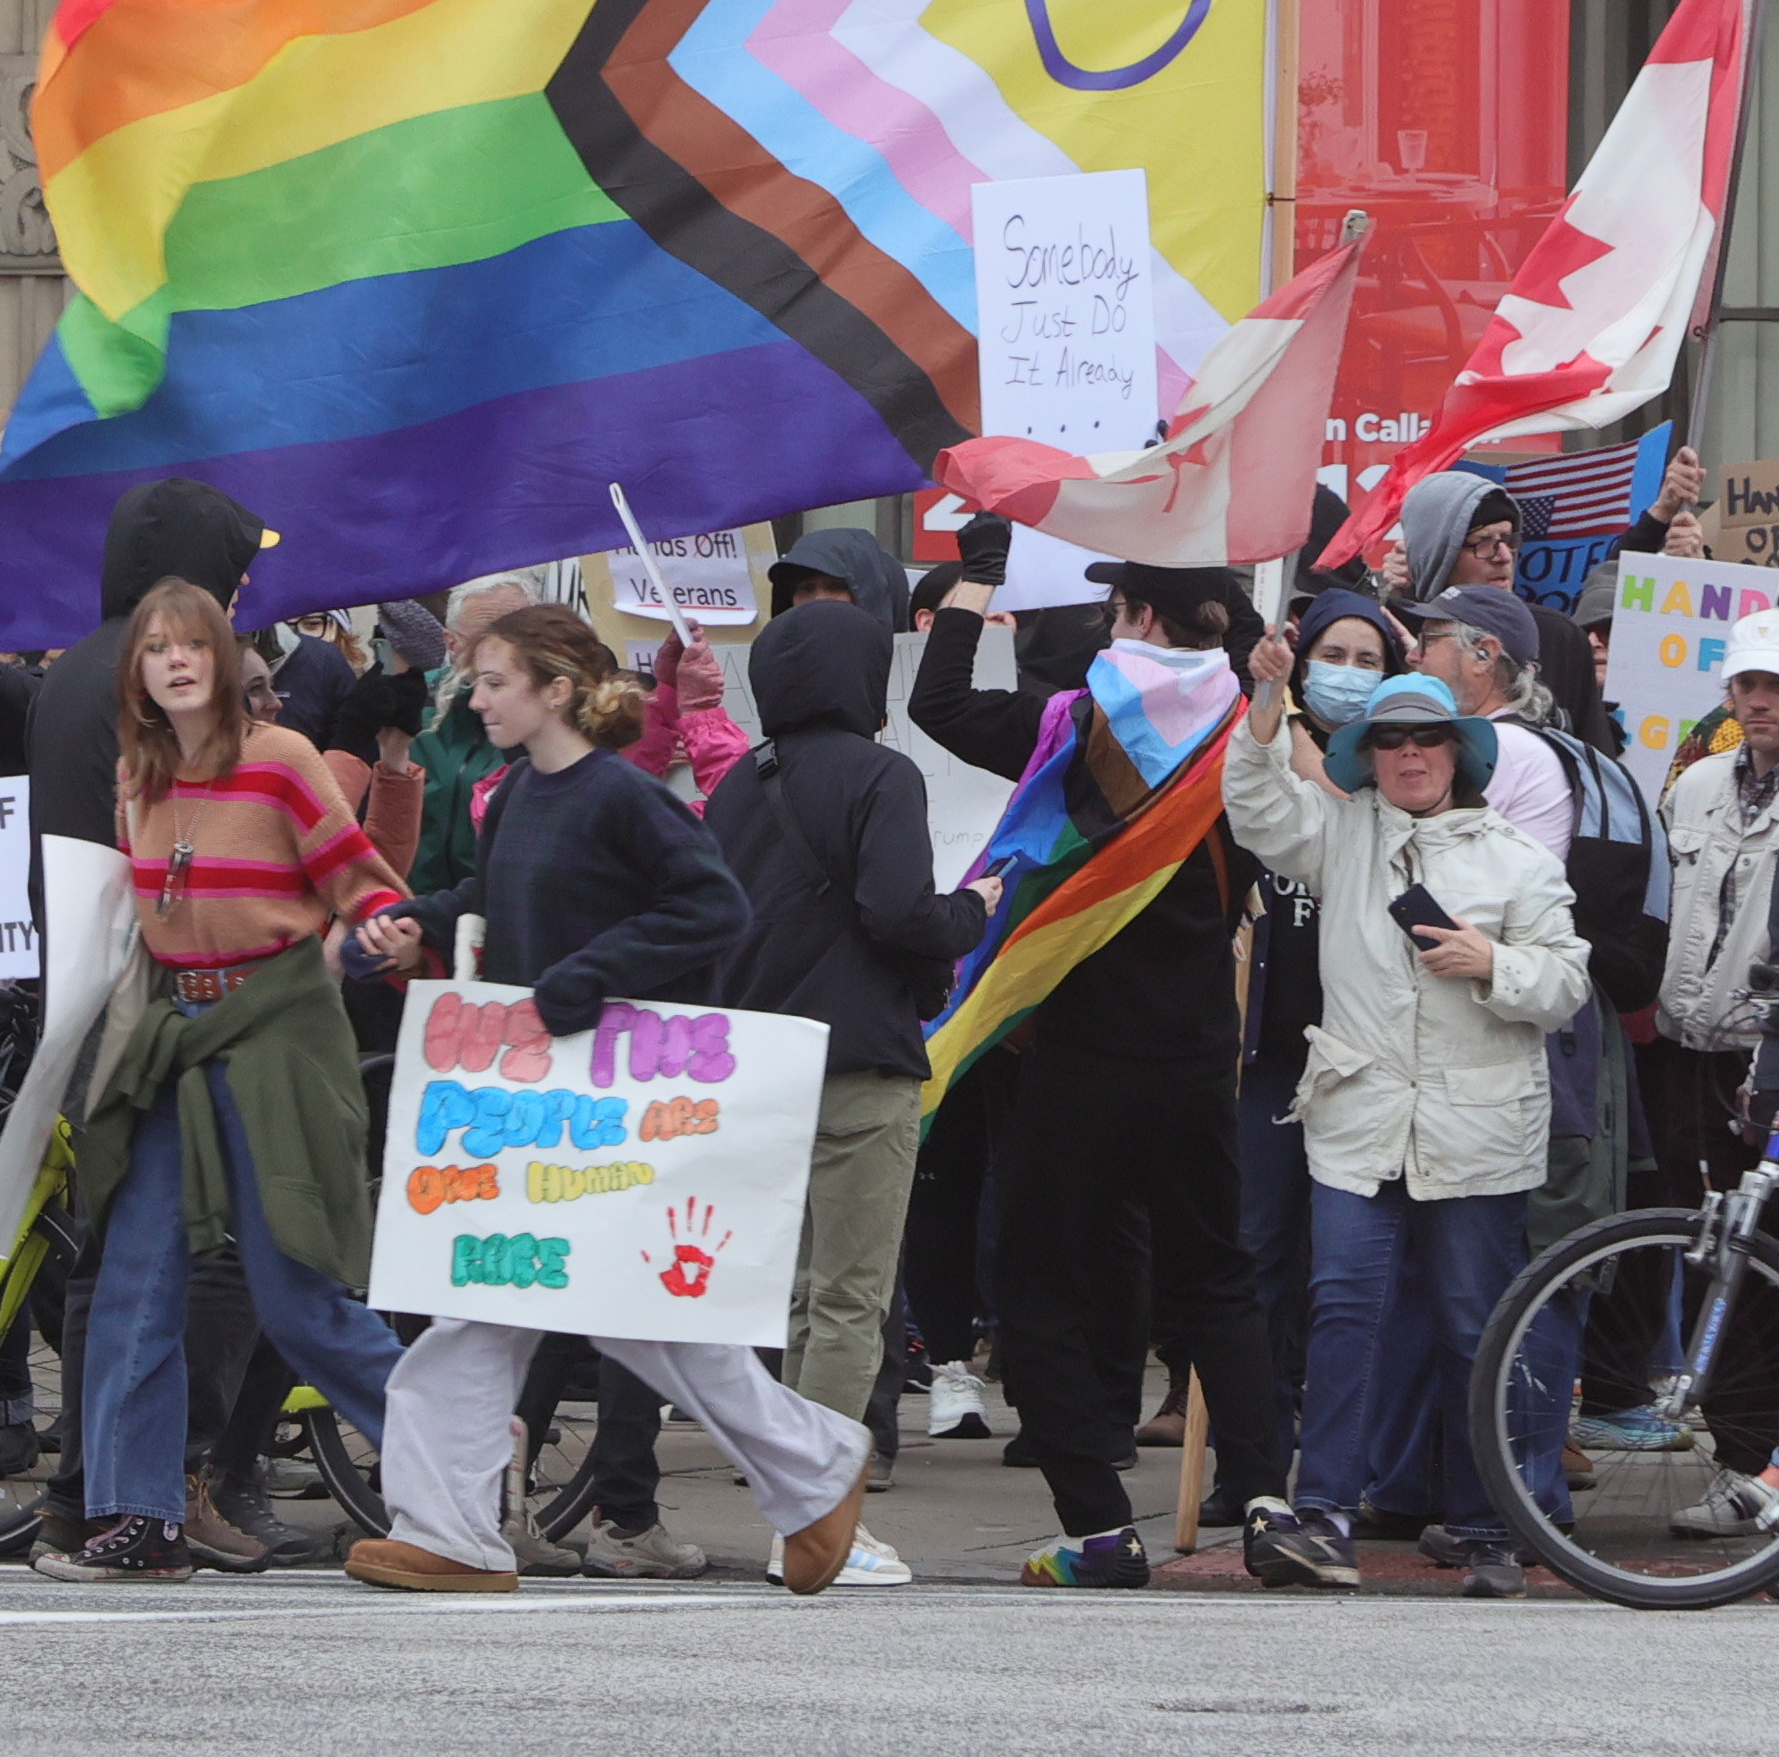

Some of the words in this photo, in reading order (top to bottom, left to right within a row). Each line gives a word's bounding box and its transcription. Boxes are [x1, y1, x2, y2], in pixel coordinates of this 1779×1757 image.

[1003, 213, 1141, 301] Somebody
[1001, 300, 1077, 344] Just
[1005, 355, 1044, 387] It
[1055, 345, 1137, 401] Already
[629, 578, 738, 607] Veerans
[416, 1080, 629, 1158] PEOPLE
[639, 1095, 720, 1142] ARE
